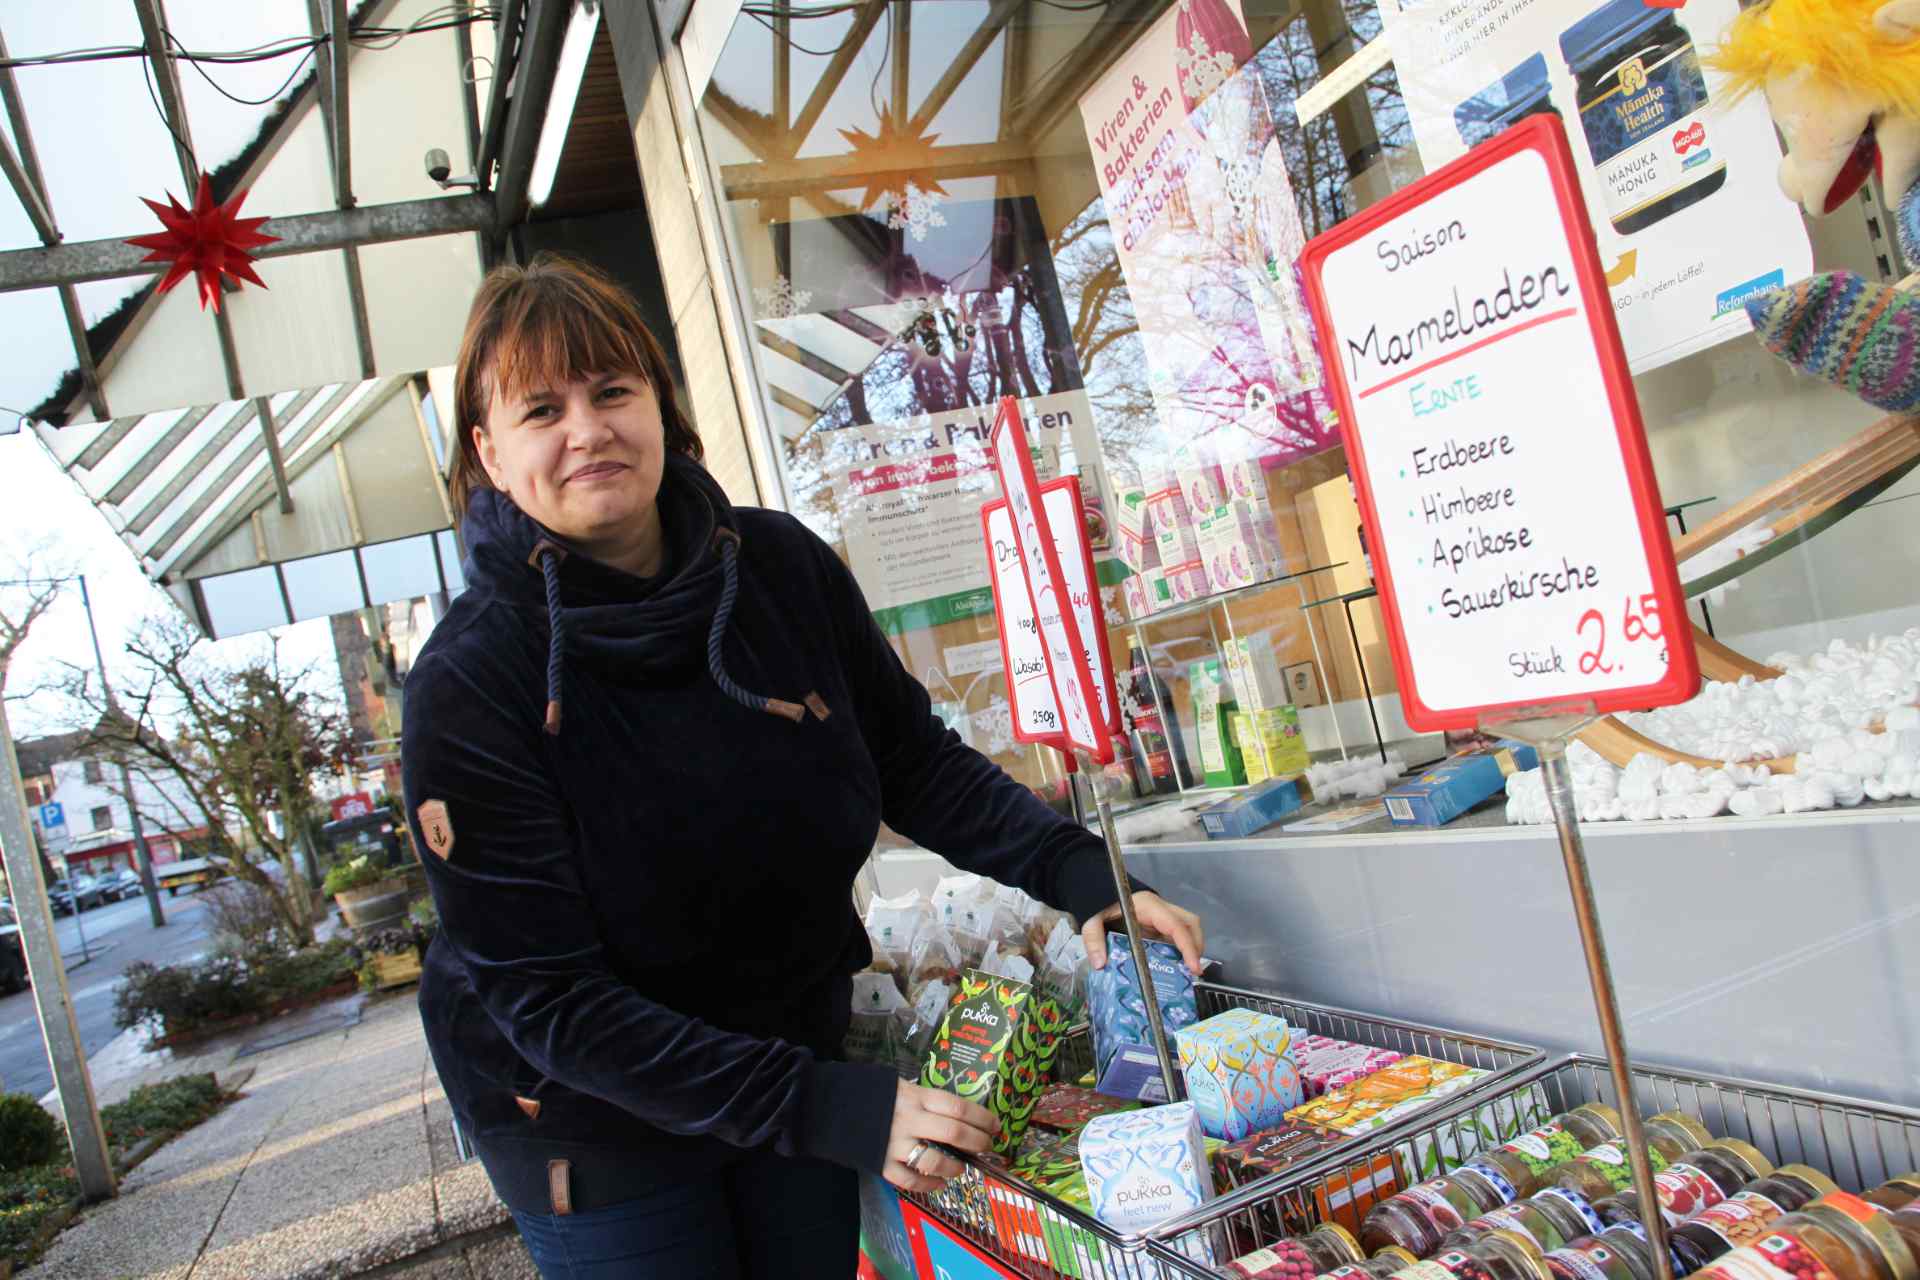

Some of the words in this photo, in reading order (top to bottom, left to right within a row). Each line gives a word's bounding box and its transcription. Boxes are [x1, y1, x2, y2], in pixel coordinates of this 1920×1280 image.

[1095, 97, 1134, 152] Viren
[1132, 74, 1148, 100] &
[1625, 102, 1664, 132] Health
[1103, 87, 1174, 188] Bakterien
[1617, 168, 1656, 196] HONIG
[1377, 218, 1467, 272] Saison
[1614, 295, 1633, 312] GO
[1651, 278, 1676, 301] jedem
[1718, 281, 1779, 312] Reformhaus
[1347, 265, 1570, 382] Marmeladen
[847, 436, 915, 463] iren
[923, 431, 941, 450] &
[1413, 433, 1515, 479] Erdbeere
[1421, 485, 1516, 524] Himbeere
[1432, 525, 1533, 573] Aprikose
[1440, 557, 1600, 618] Sauerkirsche
[1013, 656, 1044, 676] Wasabi
[1508, 646, 1566, 678] Stück
[45, 806, 58, 824] P
[961, 1007, 999, 1026] pukka
[1116, 1184, 1172, 1206] pukka
